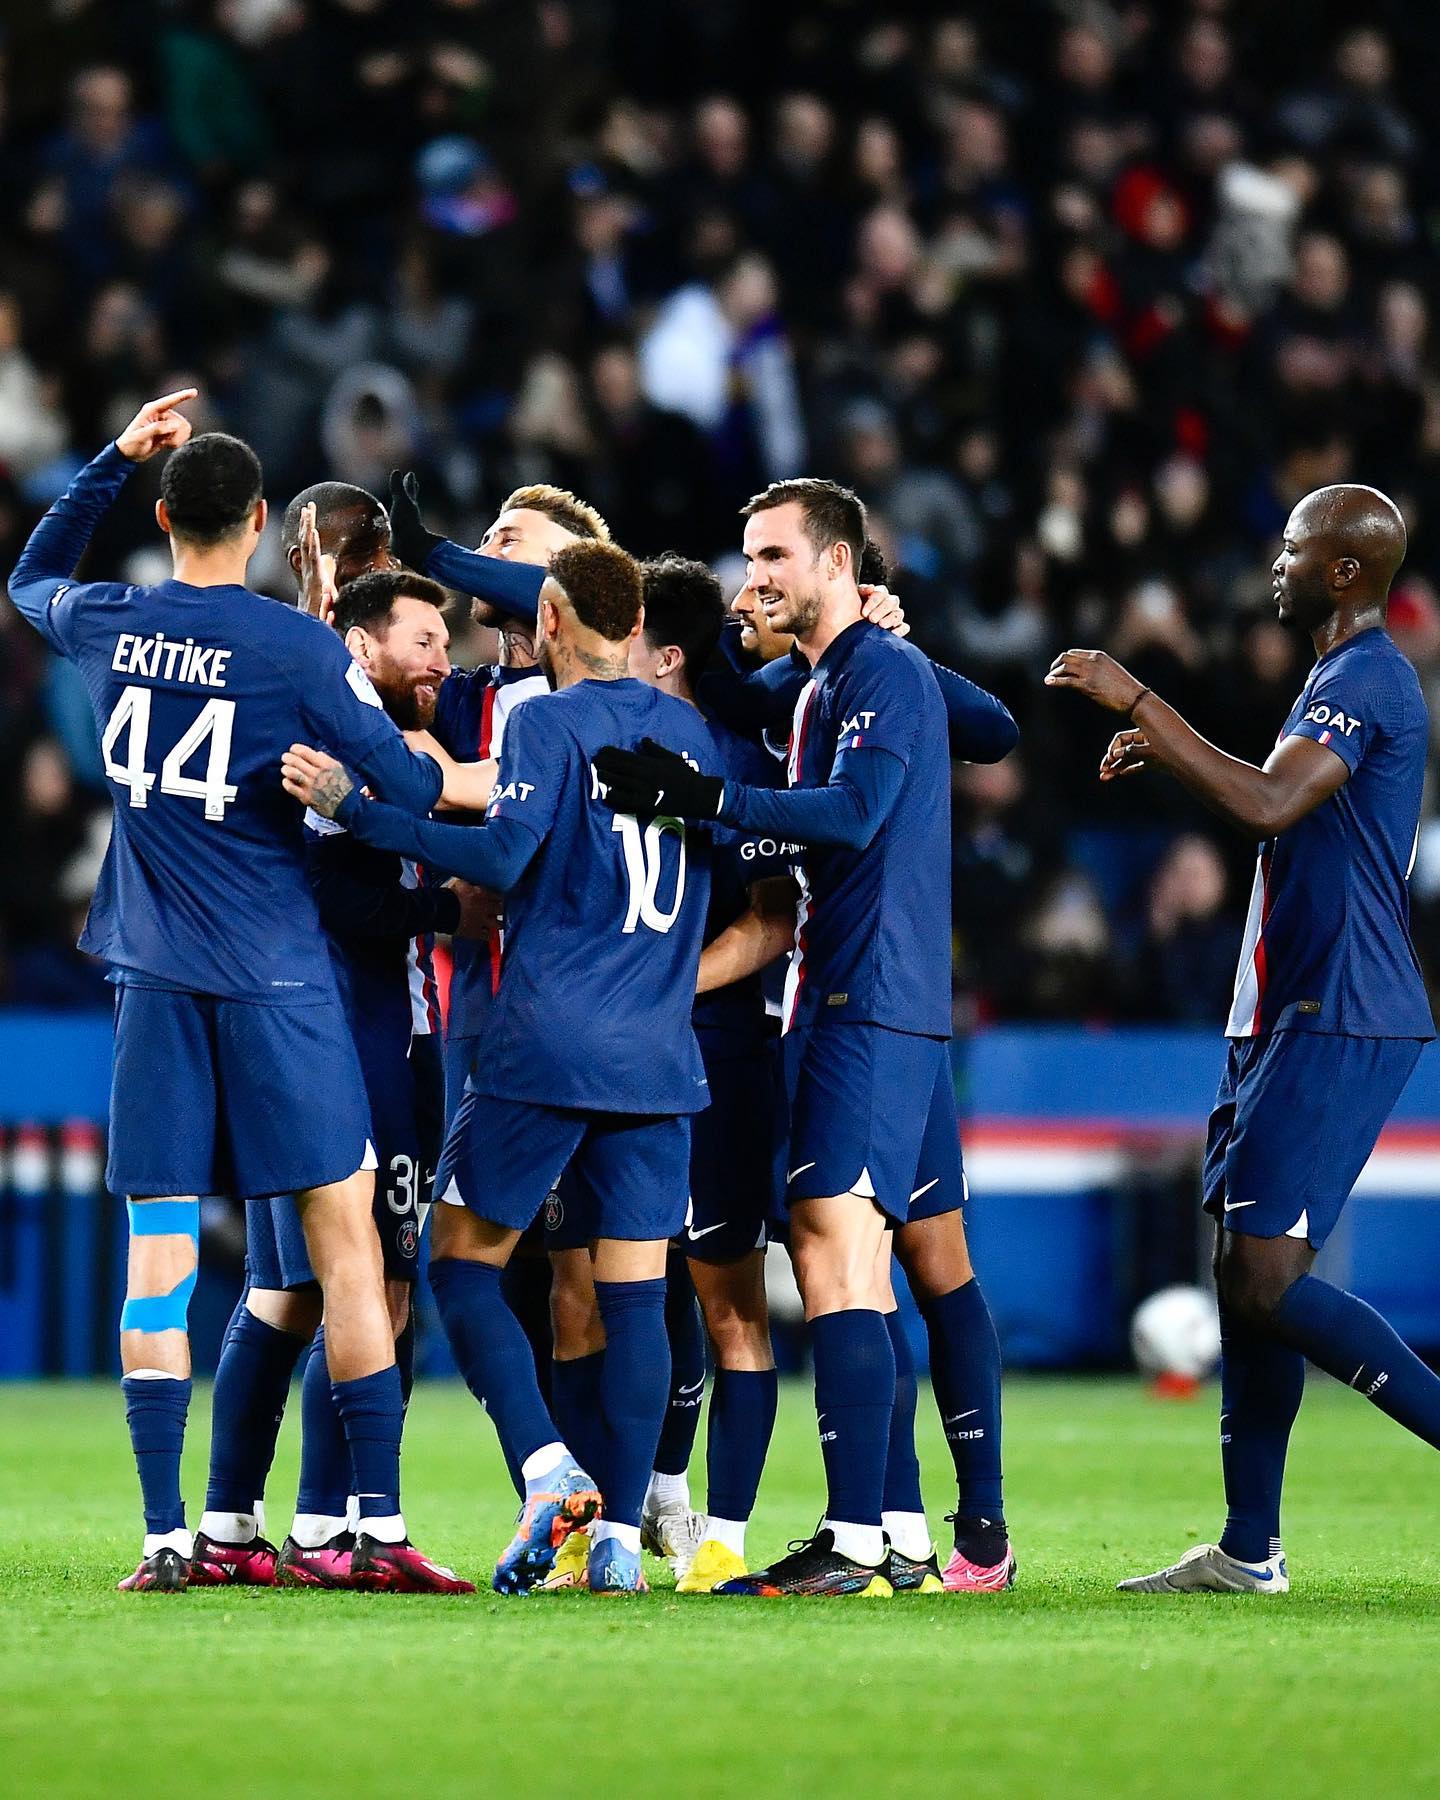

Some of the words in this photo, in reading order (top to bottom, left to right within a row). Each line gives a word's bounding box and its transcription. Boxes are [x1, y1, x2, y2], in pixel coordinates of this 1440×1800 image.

[102, 685, 238, 821] 44
[612, 813, 686, 934] 10
[387, 1154, 419, 1215] 3
